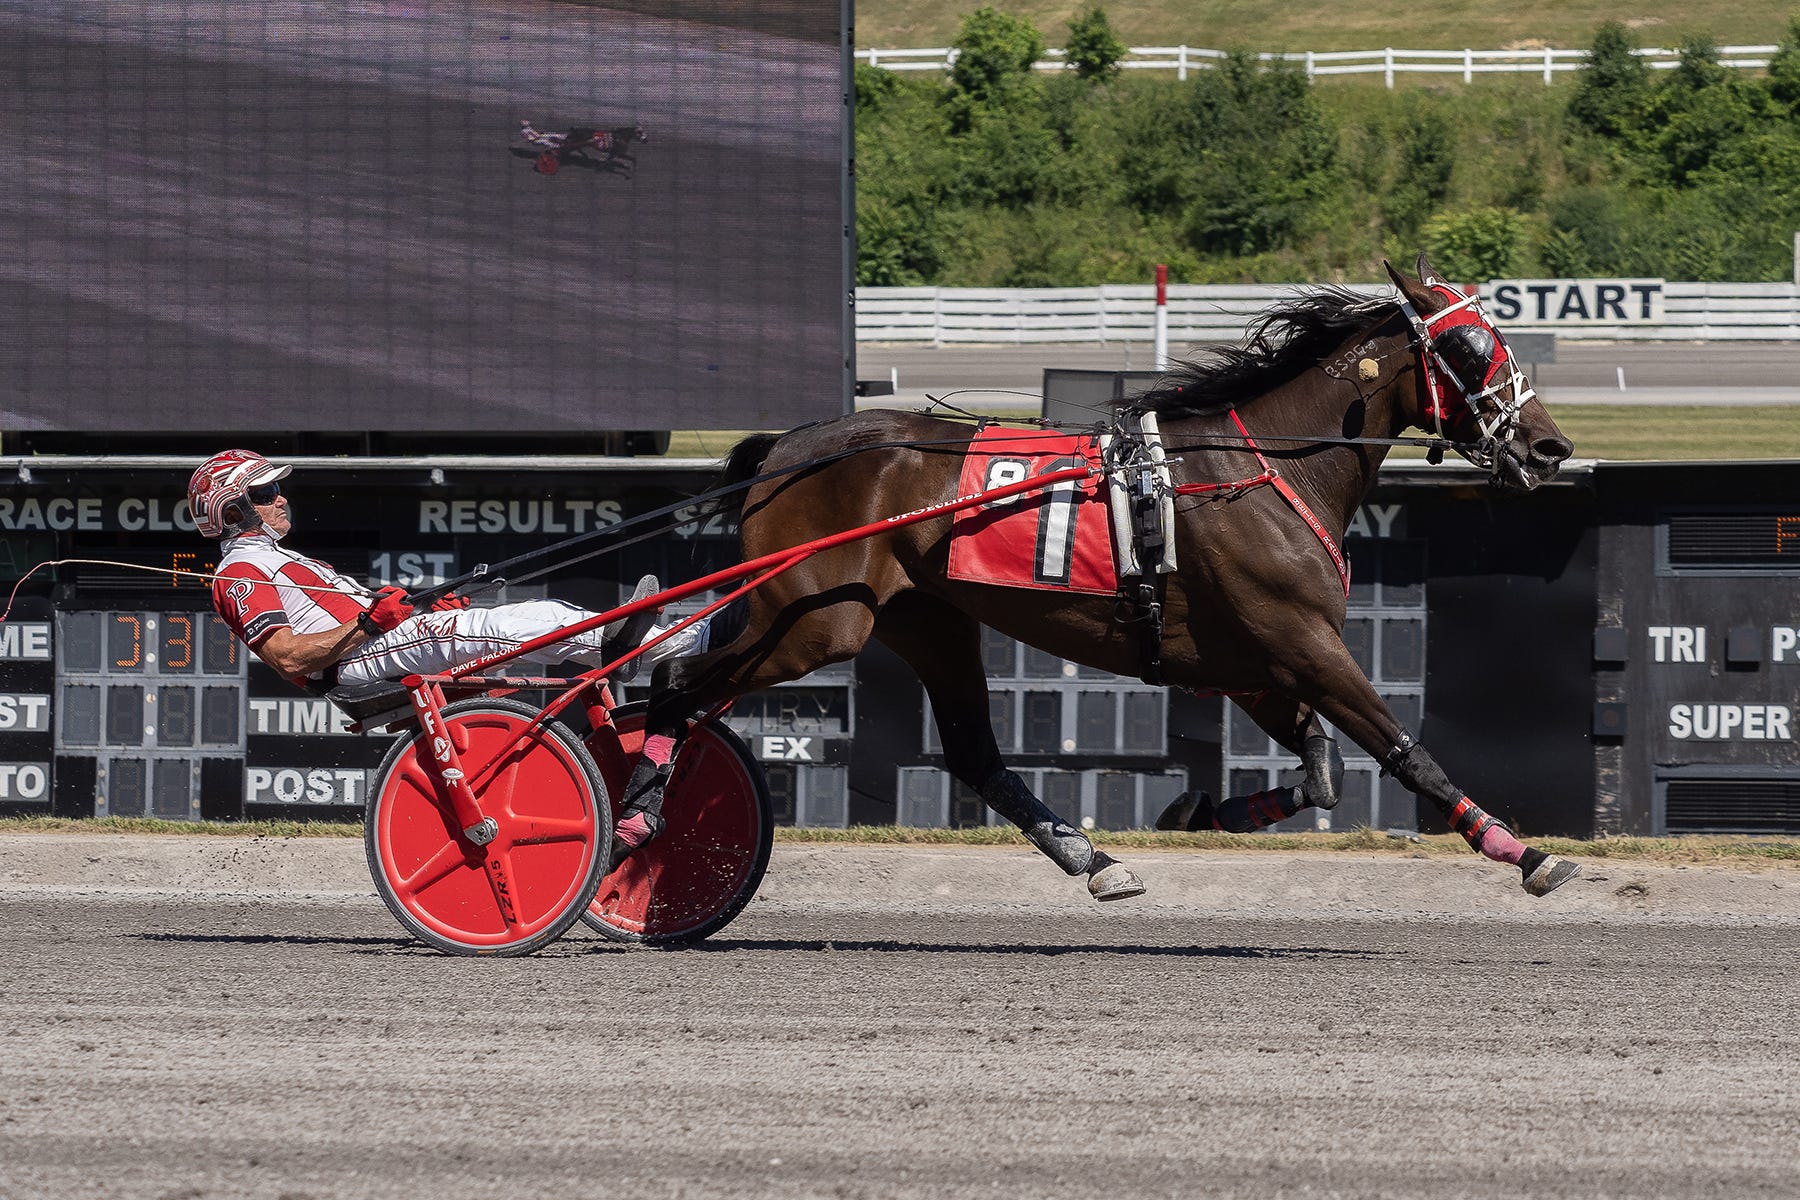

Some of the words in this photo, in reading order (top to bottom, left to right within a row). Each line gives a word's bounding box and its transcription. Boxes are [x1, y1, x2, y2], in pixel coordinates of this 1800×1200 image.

[1494, 285, 1662, 319] START
[984, 458, 1029, 507] 8
[0, 498, 103, 530] RACE
[419, 500, 623, 533] RESULTS
[1037, 461, 1083, 582] 1
[372, 553, 454, 586] 1ST
[450, 659, 478, 675] DAVE
[480, 645, 522, 664] PALONE
[1649, 627, 1705, 662] TRI
[1669, 704, 1791, 739] SUPER
[762, 737, 812, 760] EX
[246, 768, 366, 803] POST
